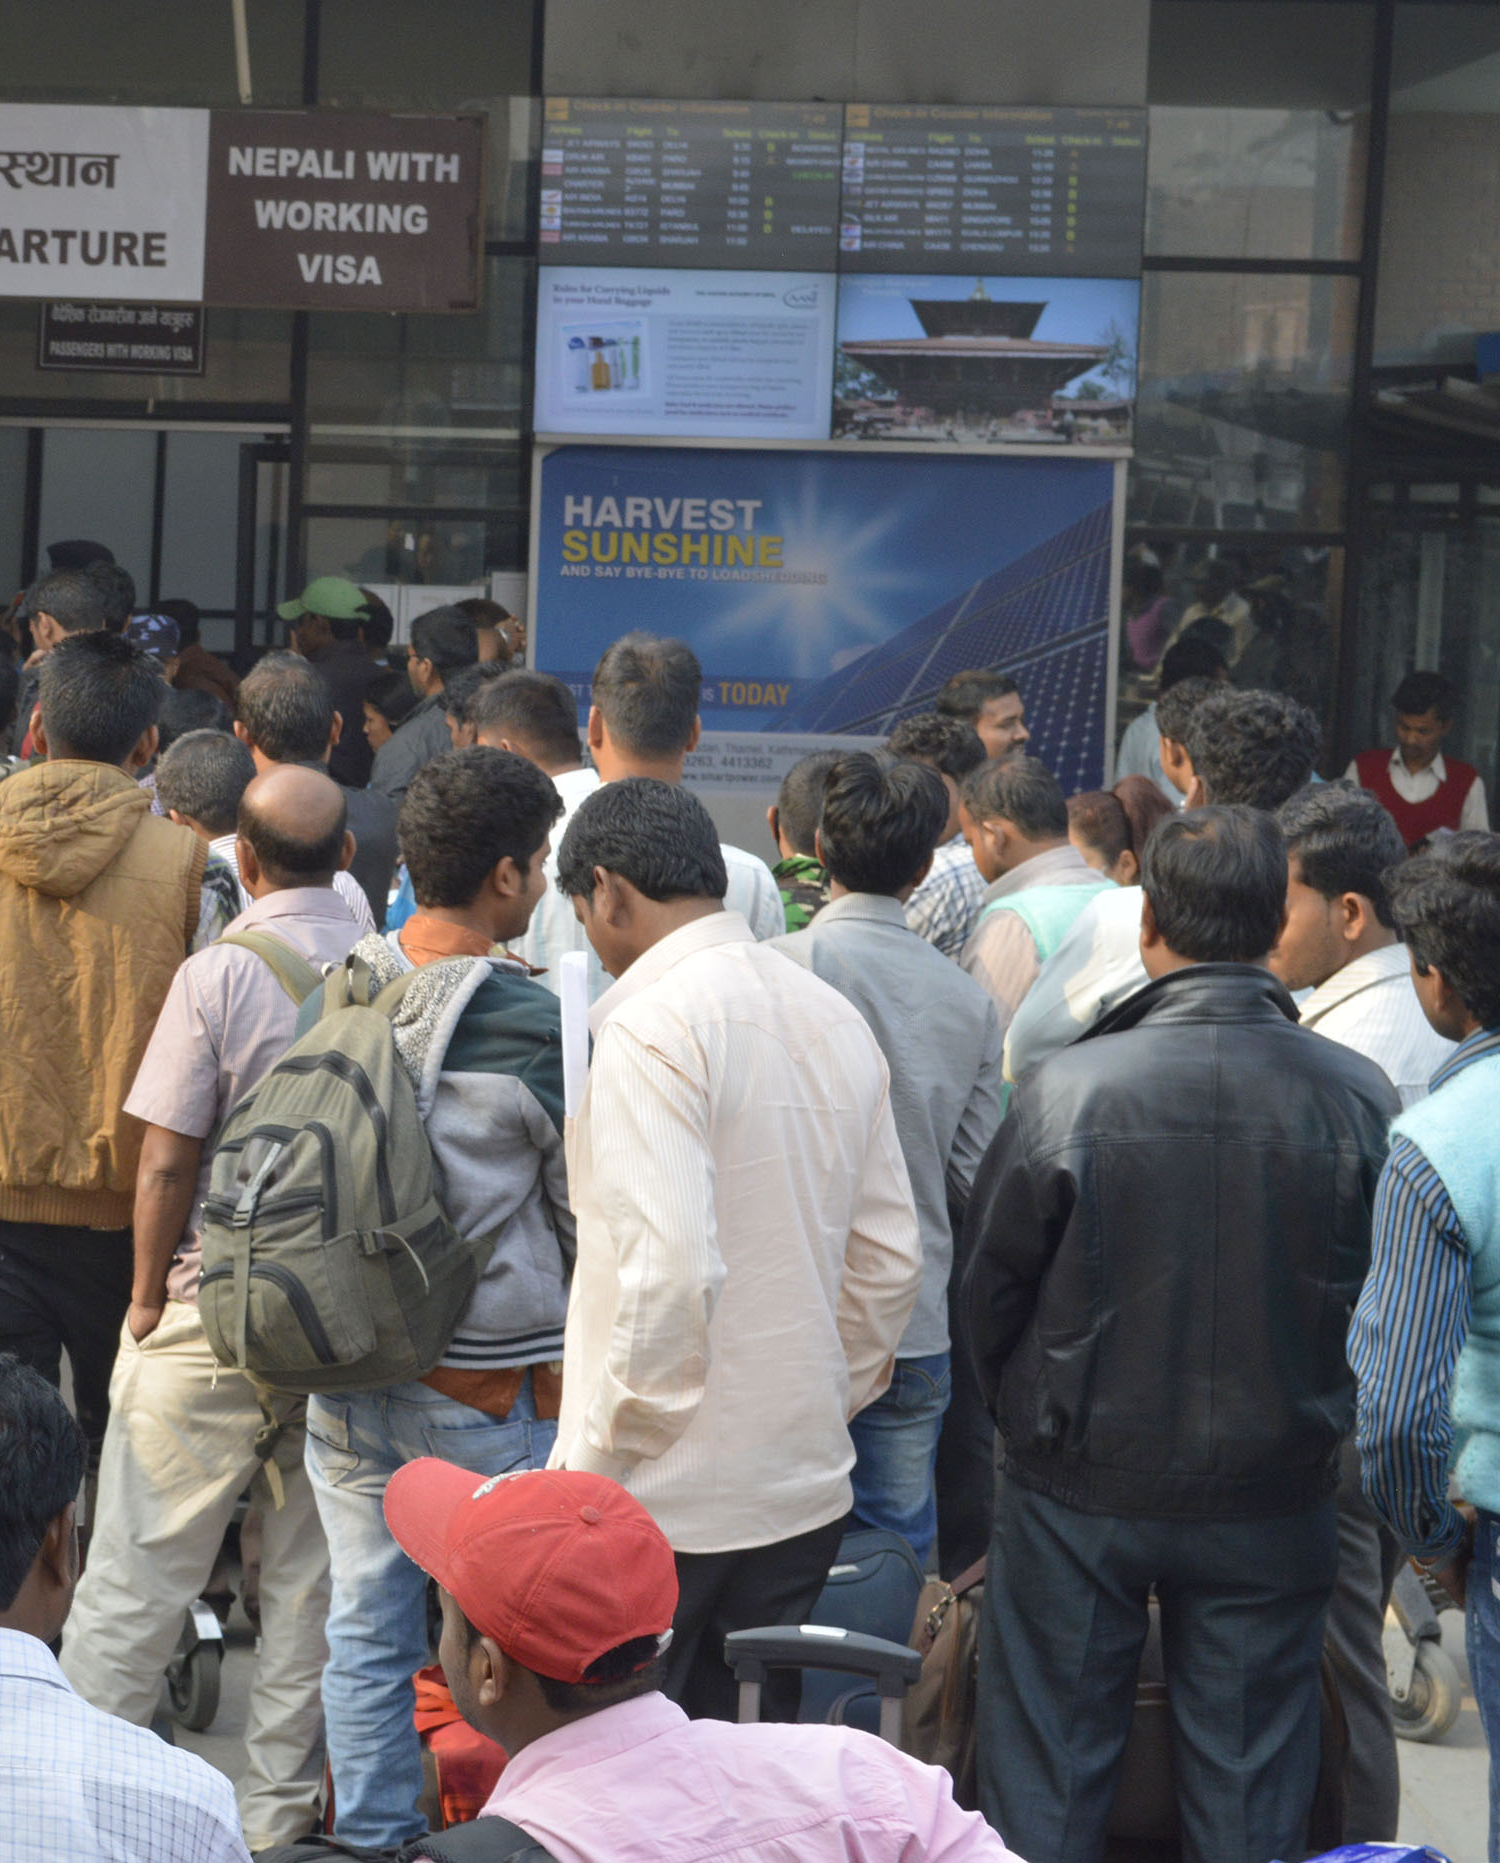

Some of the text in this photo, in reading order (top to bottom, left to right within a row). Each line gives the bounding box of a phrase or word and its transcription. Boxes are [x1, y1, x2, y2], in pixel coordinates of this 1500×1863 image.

[228, 147, 460, 183] NEPALI WITH
[255, 200, 429, 234] WORKING
[298, 253, 382, 286] VISA
[594, 284, 636, 296] Carrying
[638, 285, 670, 296] Liquids
[106, 343, 129, 359] WITH
[130, 344, 171, 361] WORKING
[172, 346, 193, 362] VISA
[564, 495, 762, 531] HARVEST
[561, 530, 785, 567] SUNSHINE
[560, 565, 828, 585] AND SAY BYE-BYE TO LOADSHEDDING
[702, 686, 714, 701] IS
[718, 682, 790, 707] TODAY
